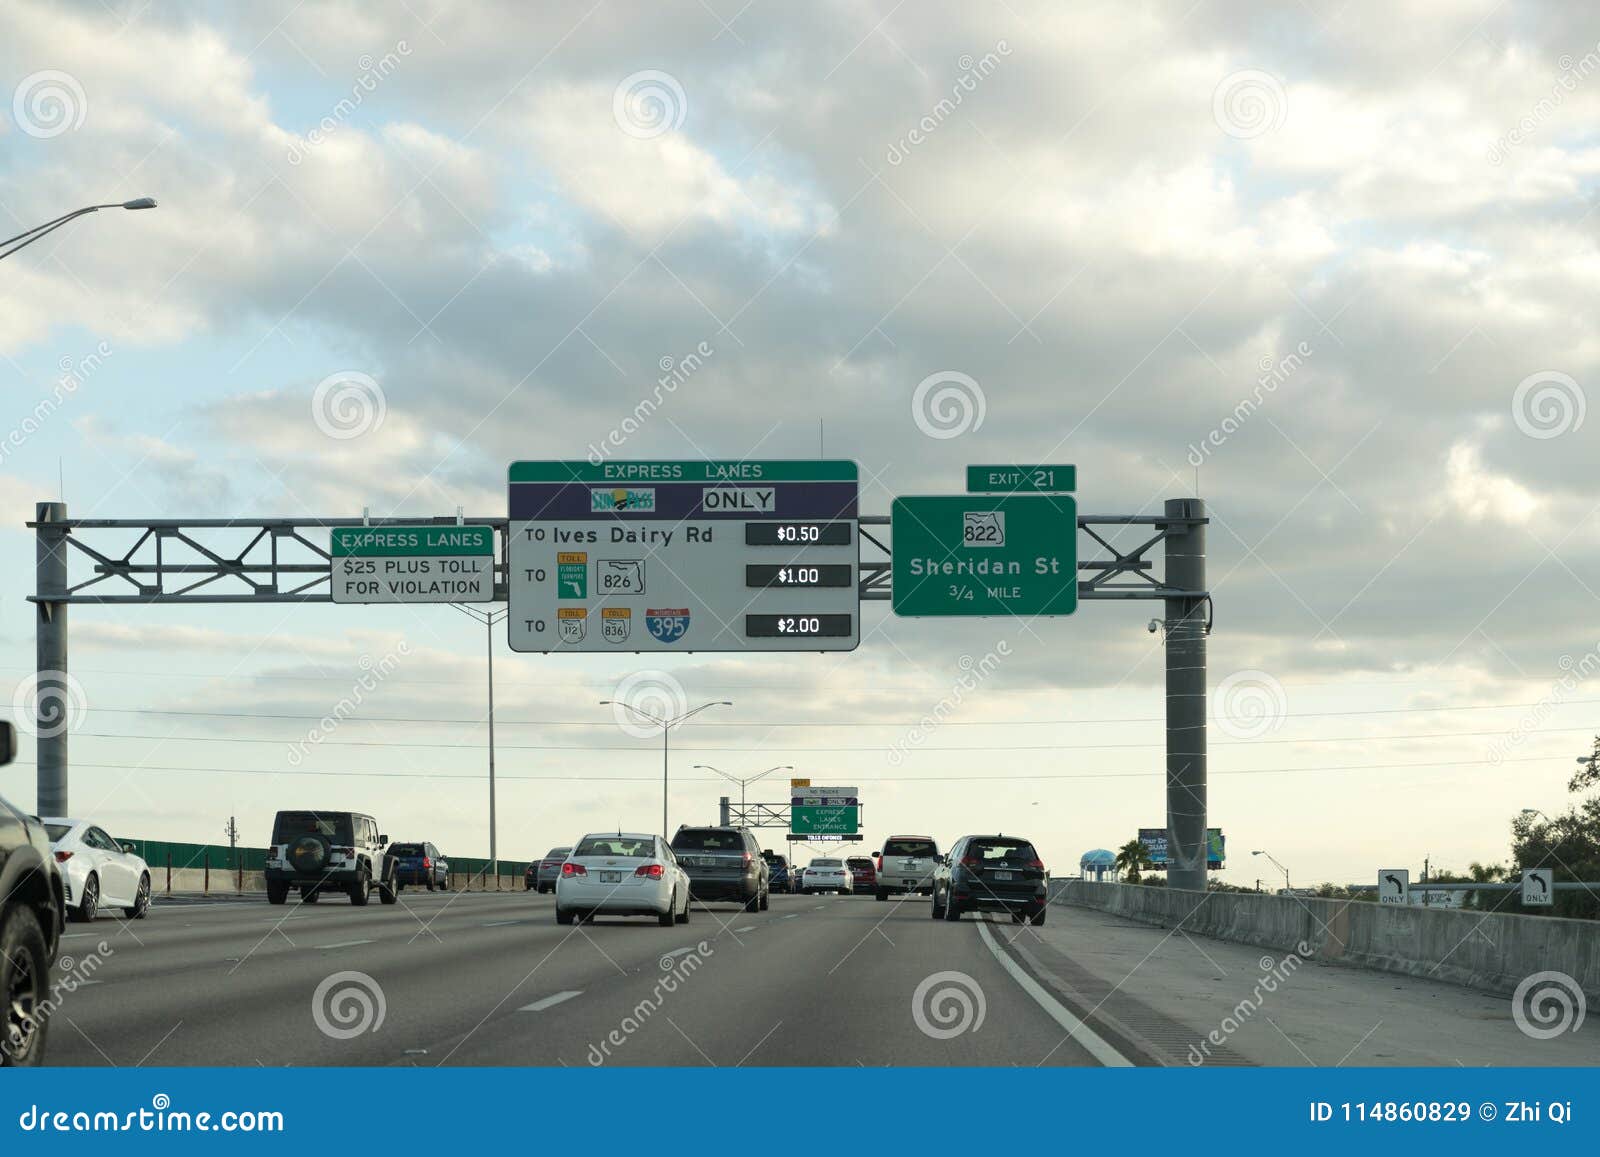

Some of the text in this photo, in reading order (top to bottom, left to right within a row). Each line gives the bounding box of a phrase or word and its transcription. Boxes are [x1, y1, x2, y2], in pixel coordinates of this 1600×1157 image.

[604, 464, 763, 478] EXPRESS LANES
[989, 471, 1054, 486] EXIT 21
[705, 491, 772, 508] ONLY
[342, 534, 483, 547] EXPRESS LANES
[525, 527, 713, 546] TO Ives Dairy Rd
[777, 526, 819, 541] $0.50
[965, 526, 997, 541] 822
[344, 560, 481, 575] $25 PLUS TOLL
[910, 557, 1060, 575] Sheridan St
[525, 569, 546, 582] TO
[604, 575, 631, 588] 826
[778, 568, 819, 583] $1.00
[346, 581, 480, 594] FOR VIOLATION
[950, 585, 1021, 600] 3/4 MILE
[525, 620, 545, 632] TO
[565, 626, 578, 635] 112
[605, 626, 624, 636] 836
[652, 617, 685, 637] 395
[777, 618, 820, 633] $2.00
